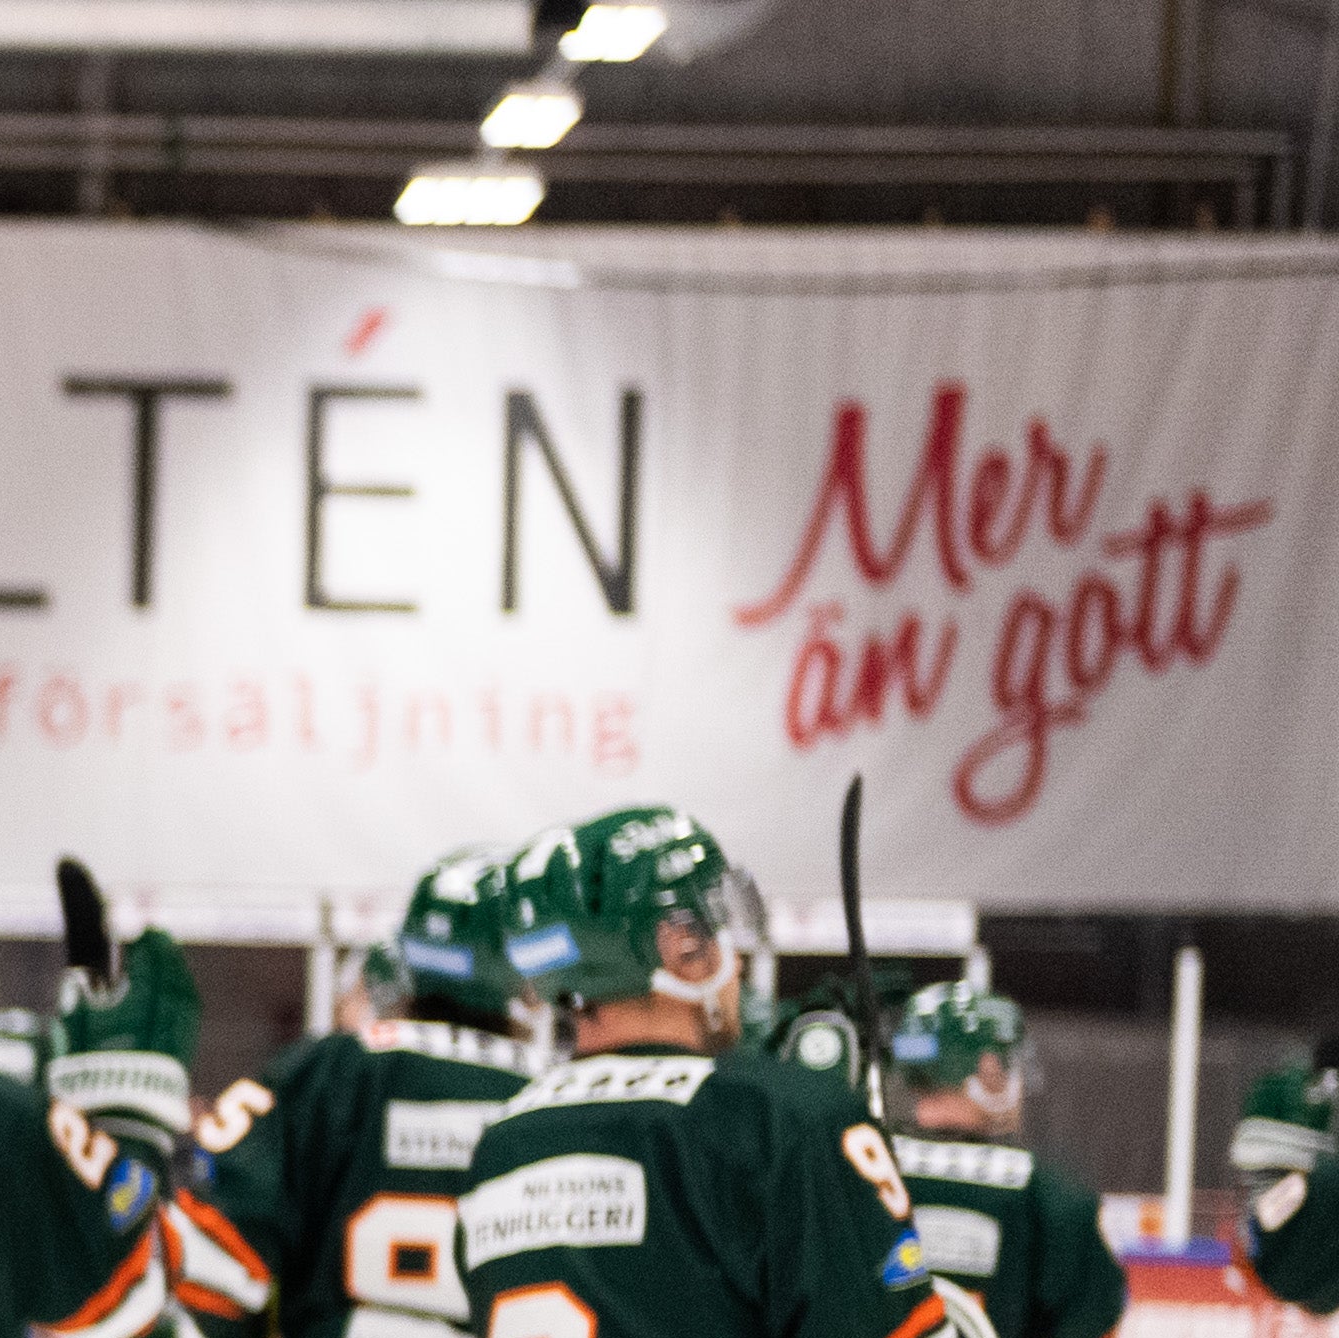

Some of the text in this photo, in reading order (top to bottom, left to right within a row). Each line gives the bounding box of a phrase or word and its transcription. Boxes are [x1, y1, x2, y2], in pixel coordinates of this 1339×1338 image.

[731, 377, 1108, 627] Mer
[784, 484, 1275, 828] än gott
